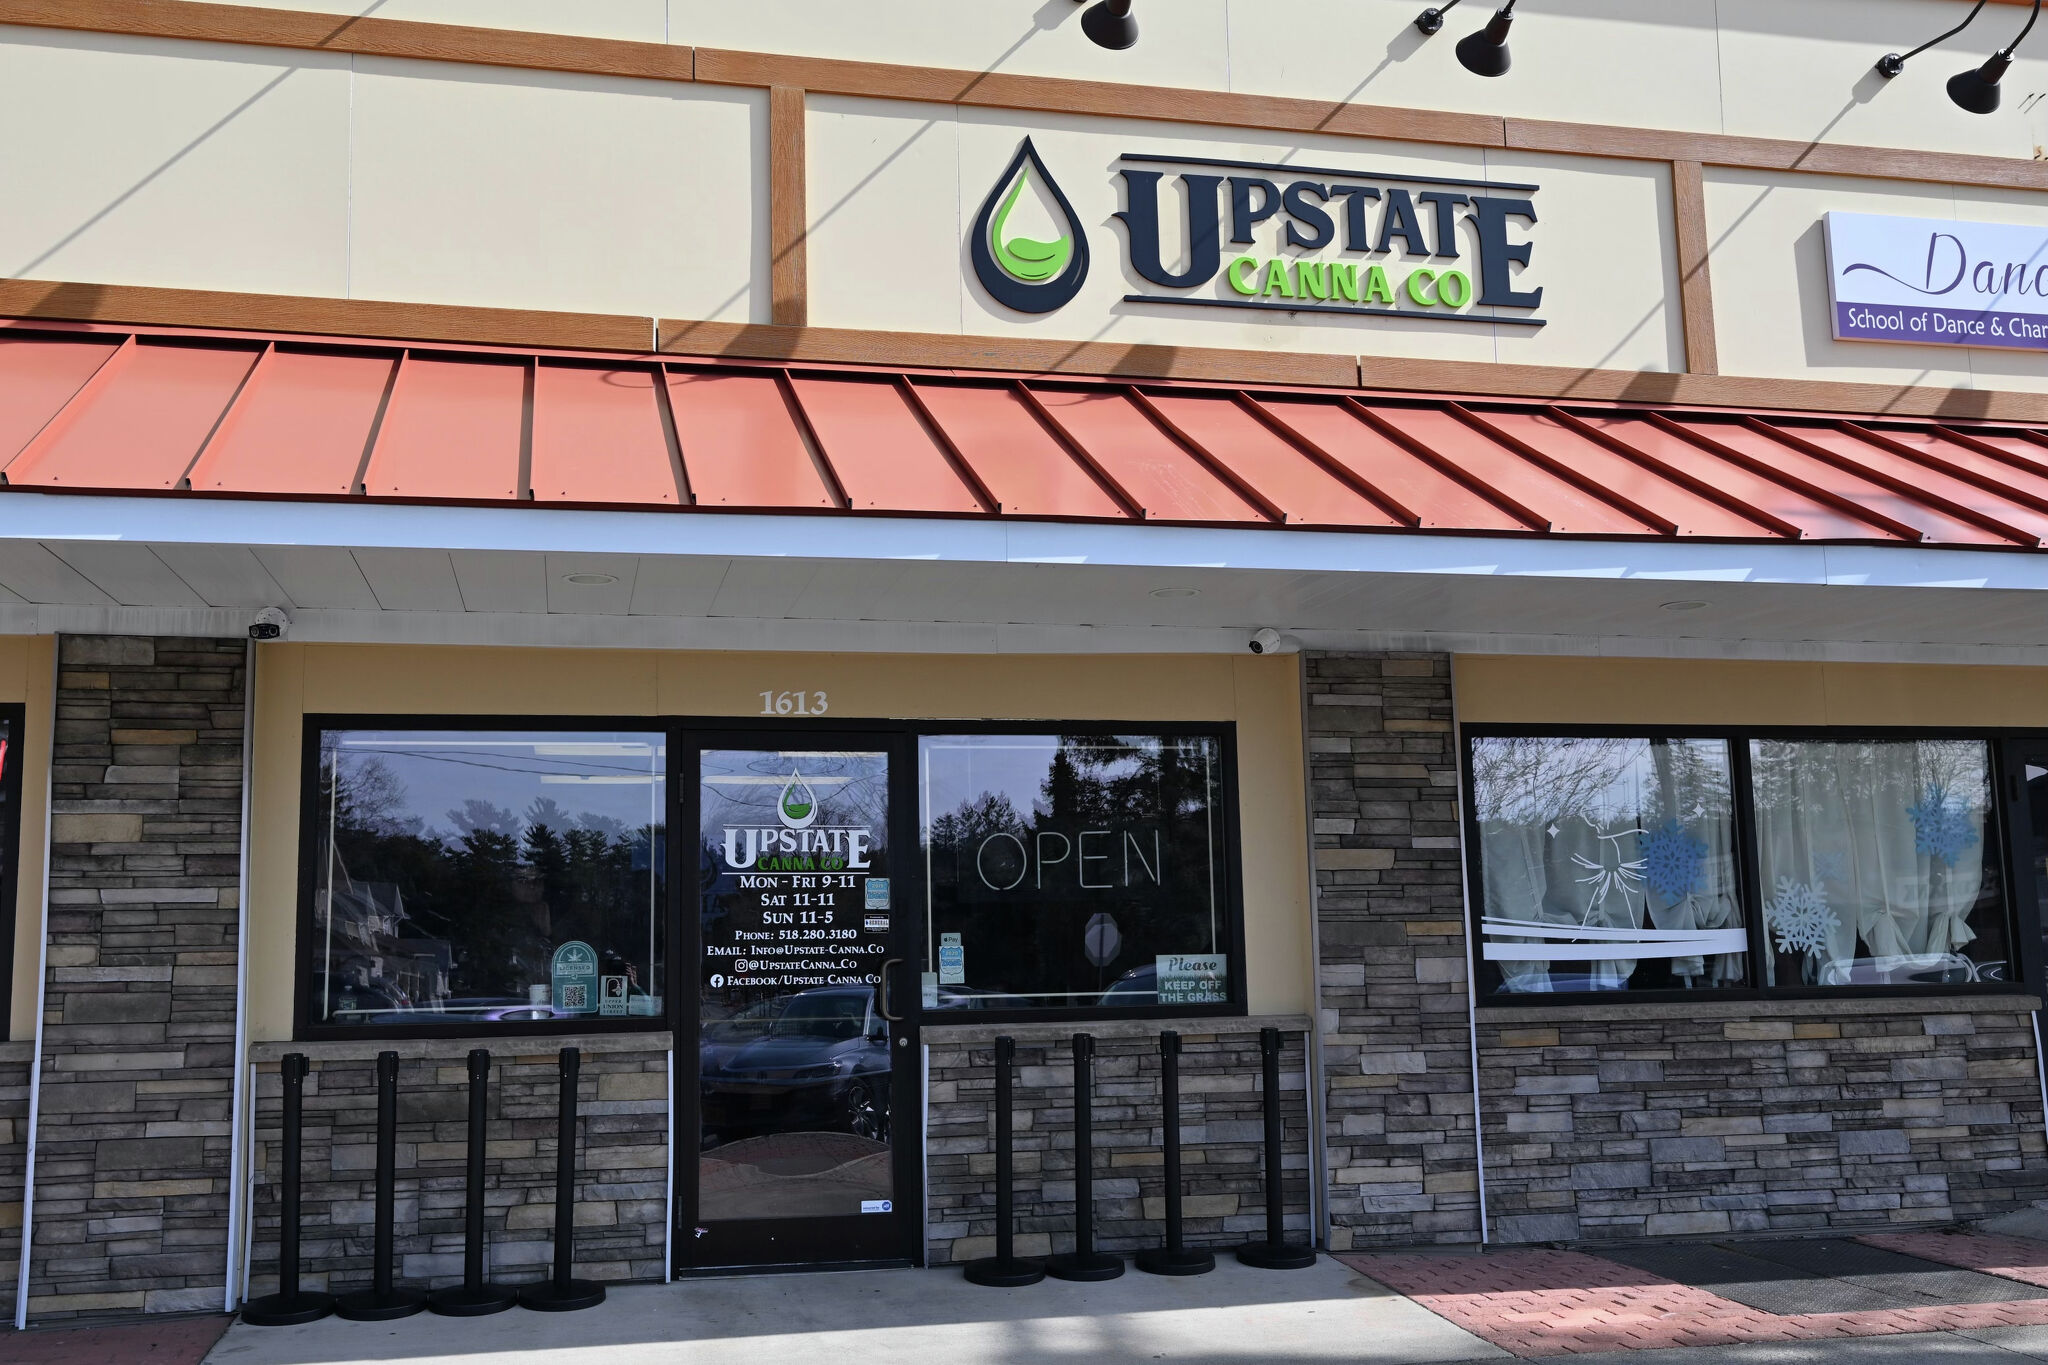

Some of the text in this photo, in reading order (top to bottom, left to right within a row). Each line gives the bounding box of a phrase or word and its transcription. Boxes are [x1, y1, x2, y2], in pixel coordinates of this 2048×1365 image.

[1112, 169, 1543, 309] UPSTATE
[1229, 256, 1471, 307] CANNA CO
[1848, 308, 1904, 330] School
[1910, 312, 1928, 332] of
[1933, 313, 1985, 336] Dance
[1990, 316, 2005, 336] &
[759, 690, 829, 715] 1613
[720, 829, 872, 868] UPSTATE
[757, 856, 844, 871] CANNA CO
[977, 830, 1161, 890] OPEN
[822, 876, 856, 888] 9-11
[793, 893, 835, 906] 11-11
[800, 911, 834, 924] 11-5
[778, 929, 857, 940] 518.280.3180
[948, 936, 959, 944] Pay
[1168, 956, 1218, 972] Please
[1164, 980, 1222, 991] KEEP OFF
[1159, 992, 1227, 1003] THE GRASS
